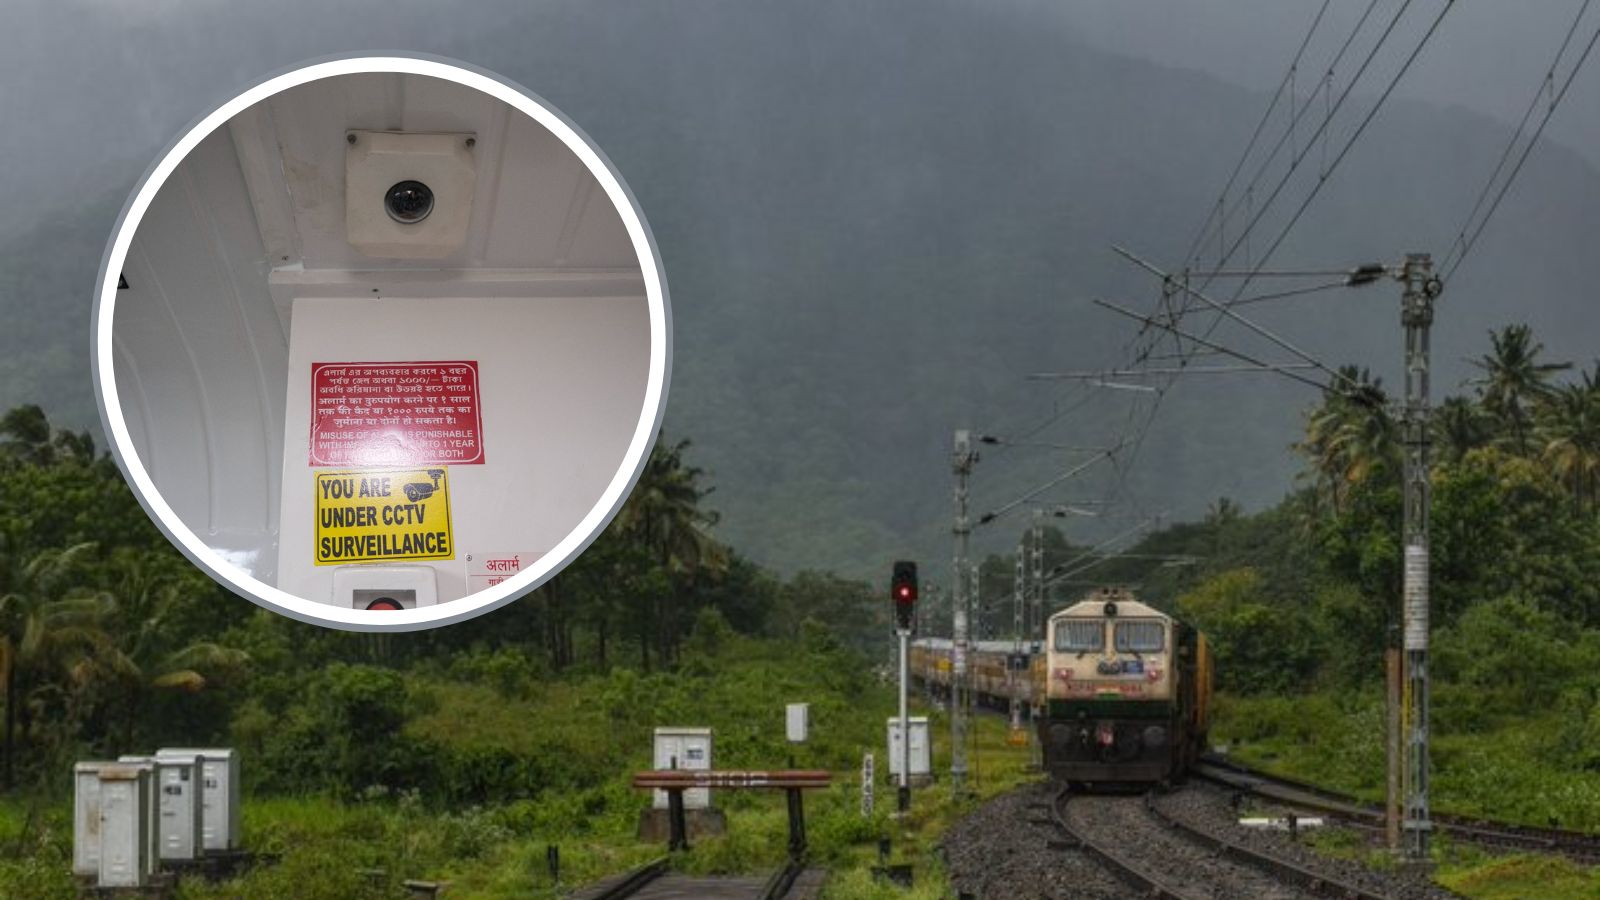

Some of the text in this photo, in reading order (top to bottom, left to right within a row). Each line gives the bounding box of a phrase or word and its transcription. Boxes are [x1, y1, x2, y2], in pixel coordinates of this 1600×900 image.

[403, 395, 424, 404] करने
[437, 406, 455, 414] तक
[320, 431, 354, 439] MISUSE
[416, 430, 473, 438] PUNISHABLE
[438, 450, 464, 458] BOTH
[320, 477, 391, 499] YOU ARE
[321, 504, 426, 528] UNDER CCTV
[321, 531, 448, 558] SURVEILLANCE
[486, 555, 520, 571] अलार्म
